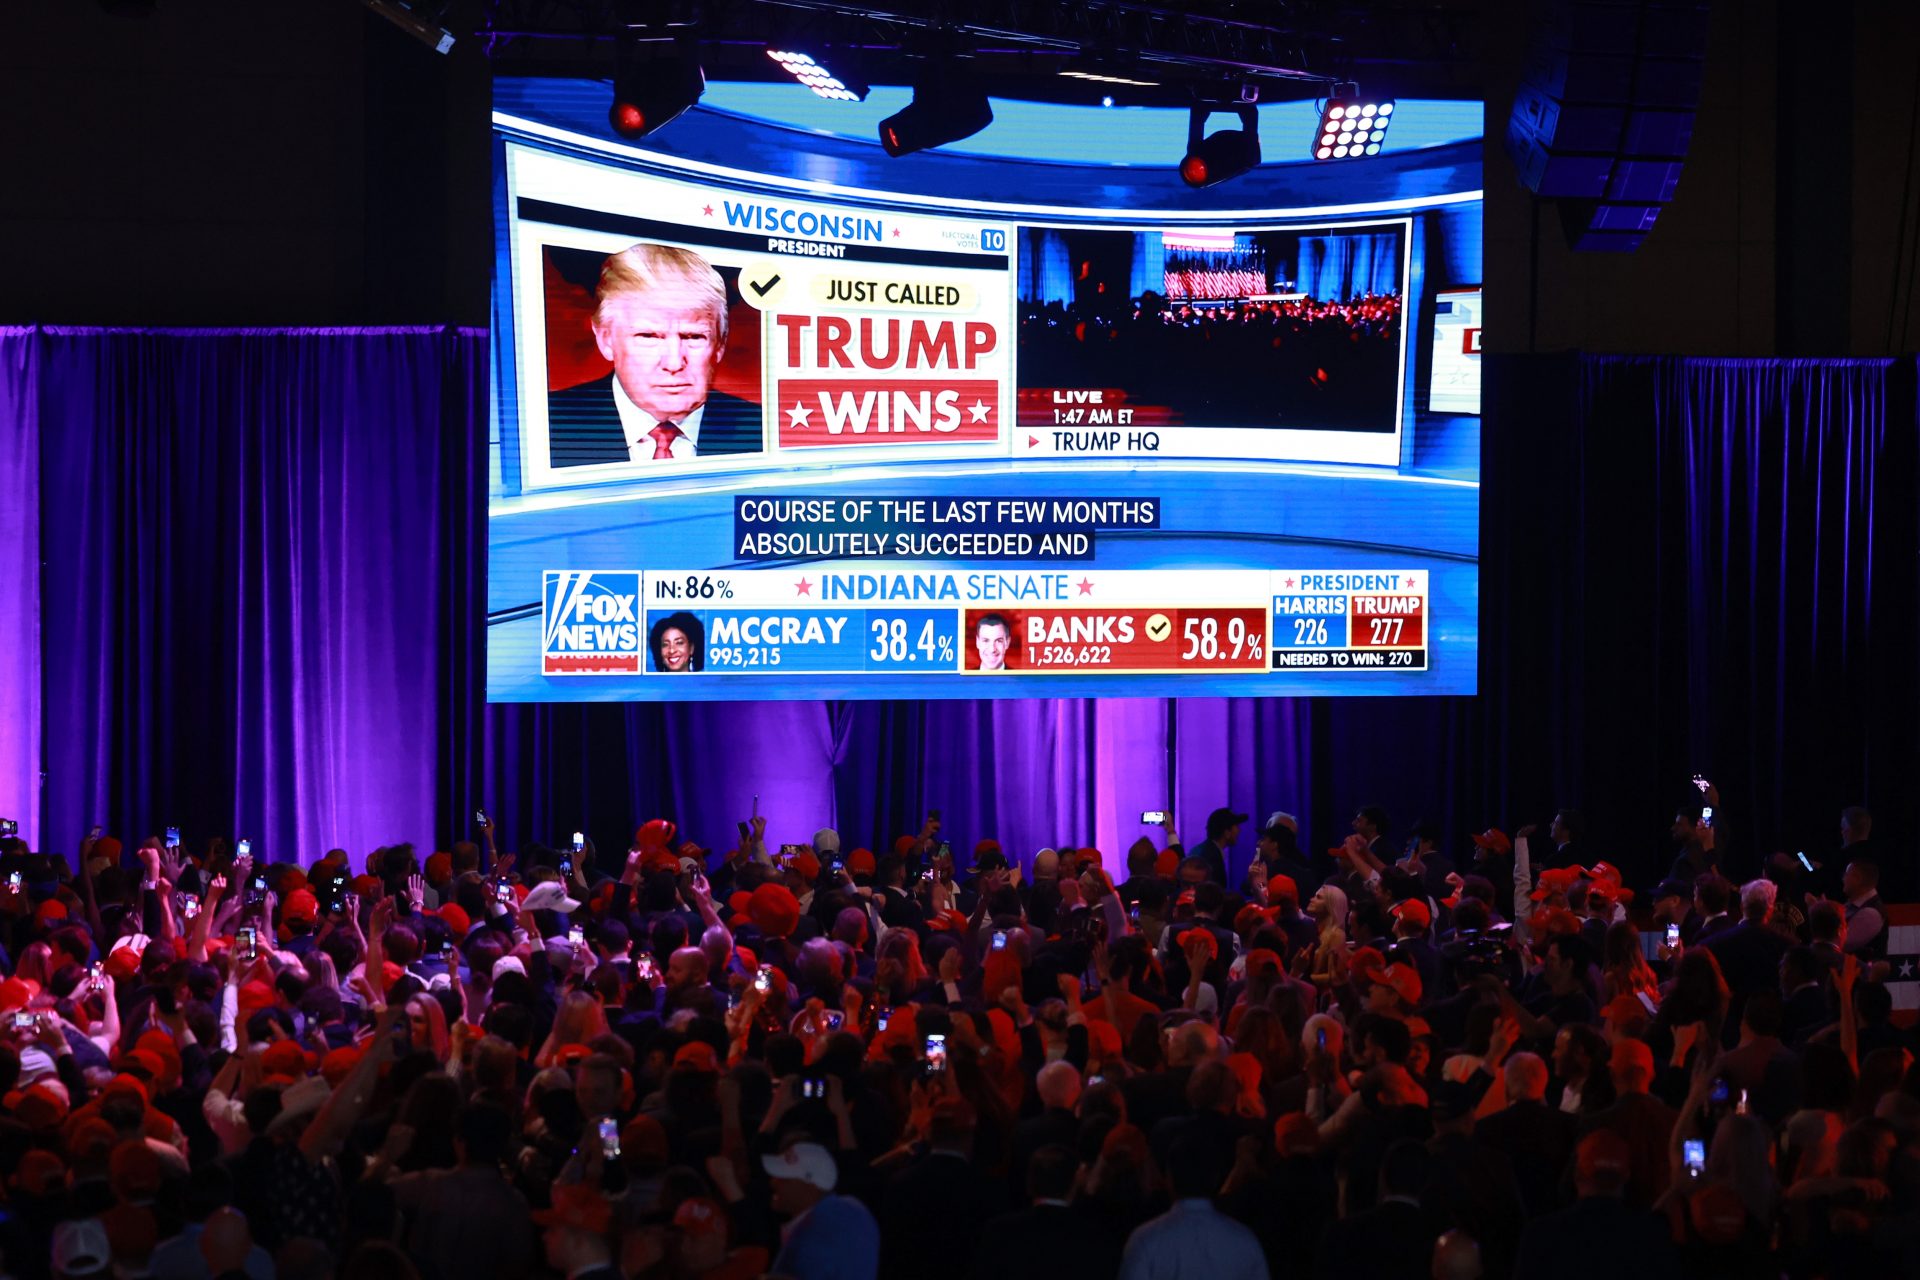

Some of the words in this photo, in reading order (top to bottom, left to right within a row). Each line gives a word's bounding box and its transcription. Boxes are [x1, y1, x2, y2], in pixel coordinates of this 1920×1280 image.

[724, 201, 882, 241] WISCONSIN
[768, 238, 846, 258] PRESIDENT
[985, 231, 1004, 249] 10
[826, 280, 878, 303] JUST
[885, 282, 961, 306] CALLED
[777, 314, 997, 370] TRUMP
[1053, 390, 1103, 404] LIVE
[818, 390, 962, 434] WINS
[1053, 409, 1085, 424] 1:47
[1088, 409, 1114, 424] AM
[1117, 409, 1134, 424] ET
[1052, 432, 1120, 451] TRUMP
[1128, 432, 1160, 451] HQ
[740, 500, 835, 523] COURSE
[842, 500, 873, 523] OF
[879, 500, 925, 523] THE
[932, 501, 992, 523] LAST
[998, 502, 1048, 523] FEW
[1053, 501, 1154, 524] MONTHS
[740, 533, 888, 556] ABSOLUTELY
[895, 533, 1033, 556] SUCCEEDED
[1039, 534, 1089, 556] AND
[821, 575, 961, 600] INDIANA
[966, 574, 1068, 600] SENATE
[1301, 575, 1400, 591] PRESIDENT
[576, 594, 635, 623] FOX
[1275, 597, 1346, 614] HARRIS
[1355, 597, 1421, 614] TRUMP
[558, 625, 638, 651] NEWS
[710, 617, 848, 645] MCCRAY
[870, 618, 954, 662] 38.4%
[1027, 616, 1135, 643] BANKS
[1182, 617, 1263, 661] 58.9%
[1293, 619, 1328, 645] 226
[1370, 618, 1404, 645] 277
[710, 648, 780, 667] 995,215
[1027, 646, 1111, 667] 1,526,622
[1280, 653, 1328, 666] NEEDED
[1331, 653, 1349, 666] TO
[1351, 653, 1384, 666] WIN:
[1389, 653, 1412, 666] 270
